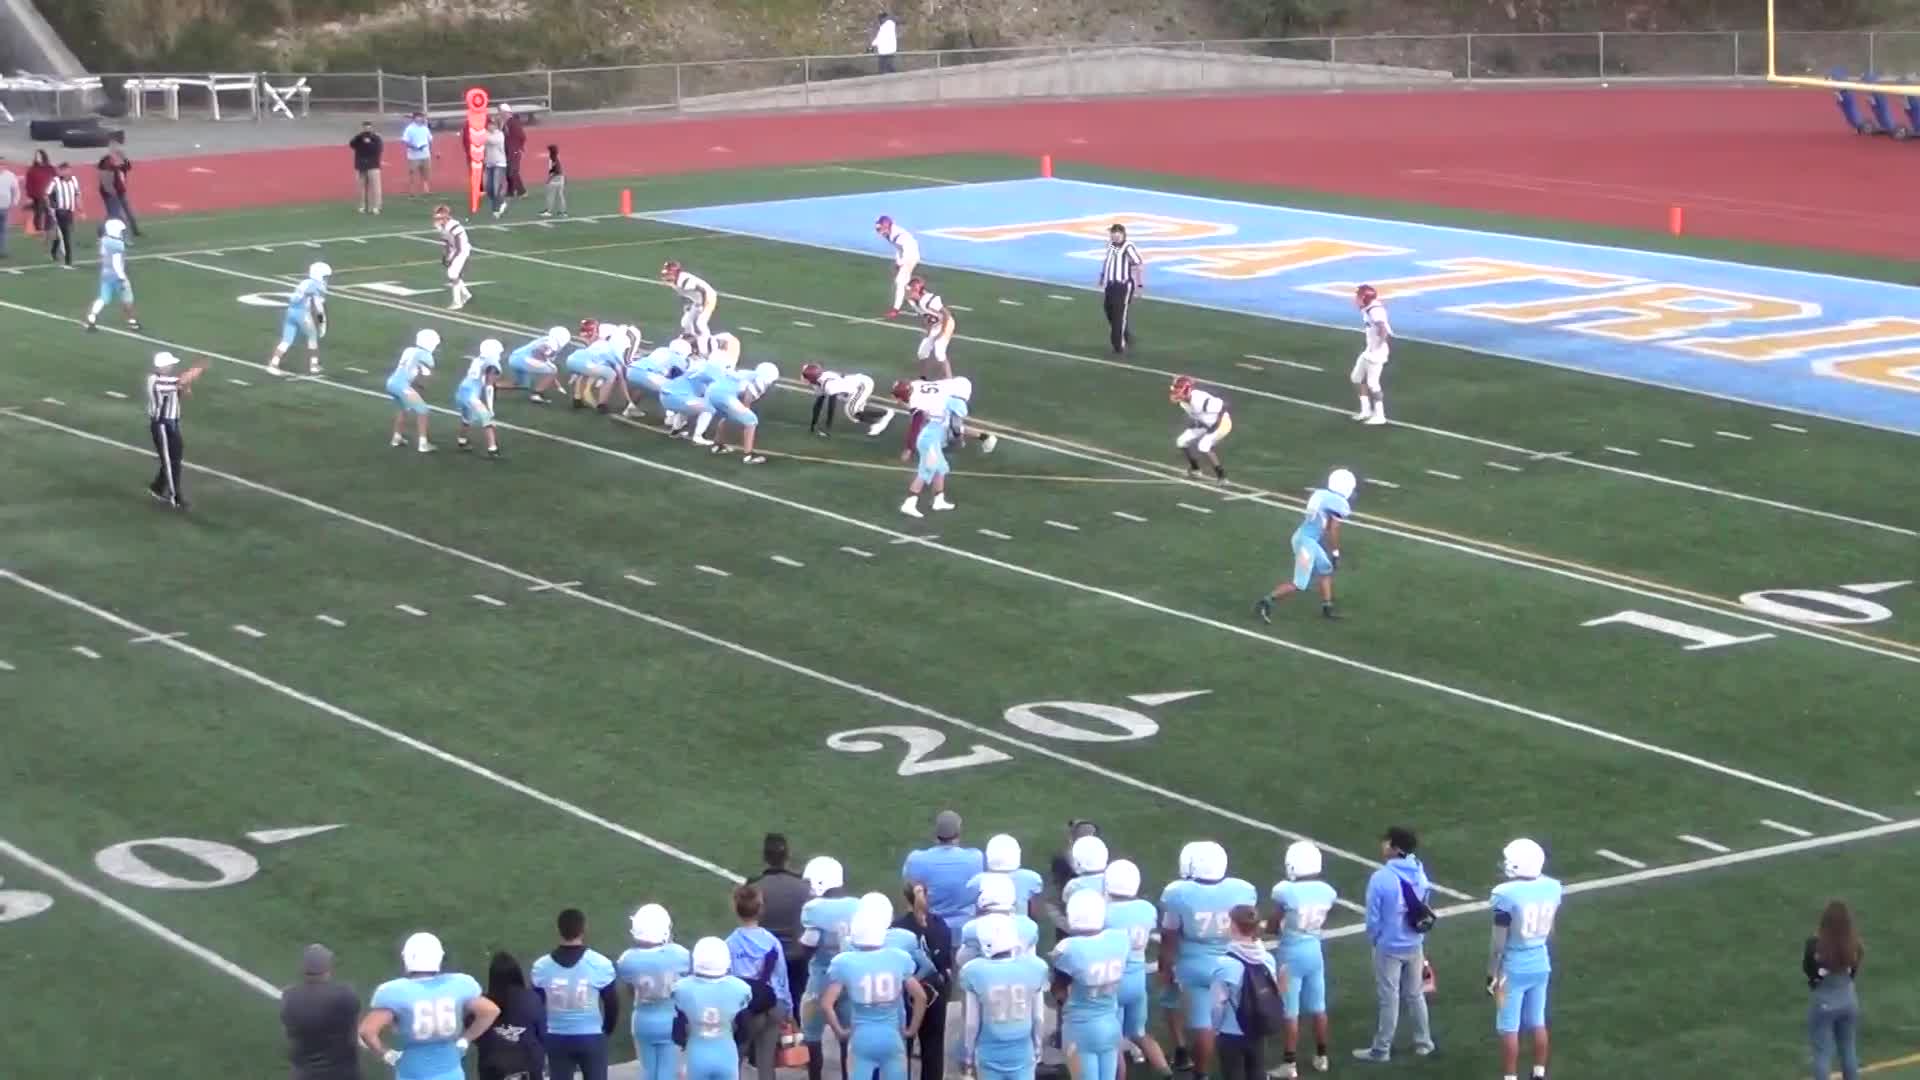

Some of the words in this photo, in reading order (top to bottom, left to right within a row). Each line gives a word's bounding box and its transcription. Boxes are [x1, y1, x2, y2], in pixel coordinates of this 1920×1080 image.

[1579, 589, 1893, 650] 10
[826, 701, 1160, 776] 20
[413, 998, 457, 1039] 66
